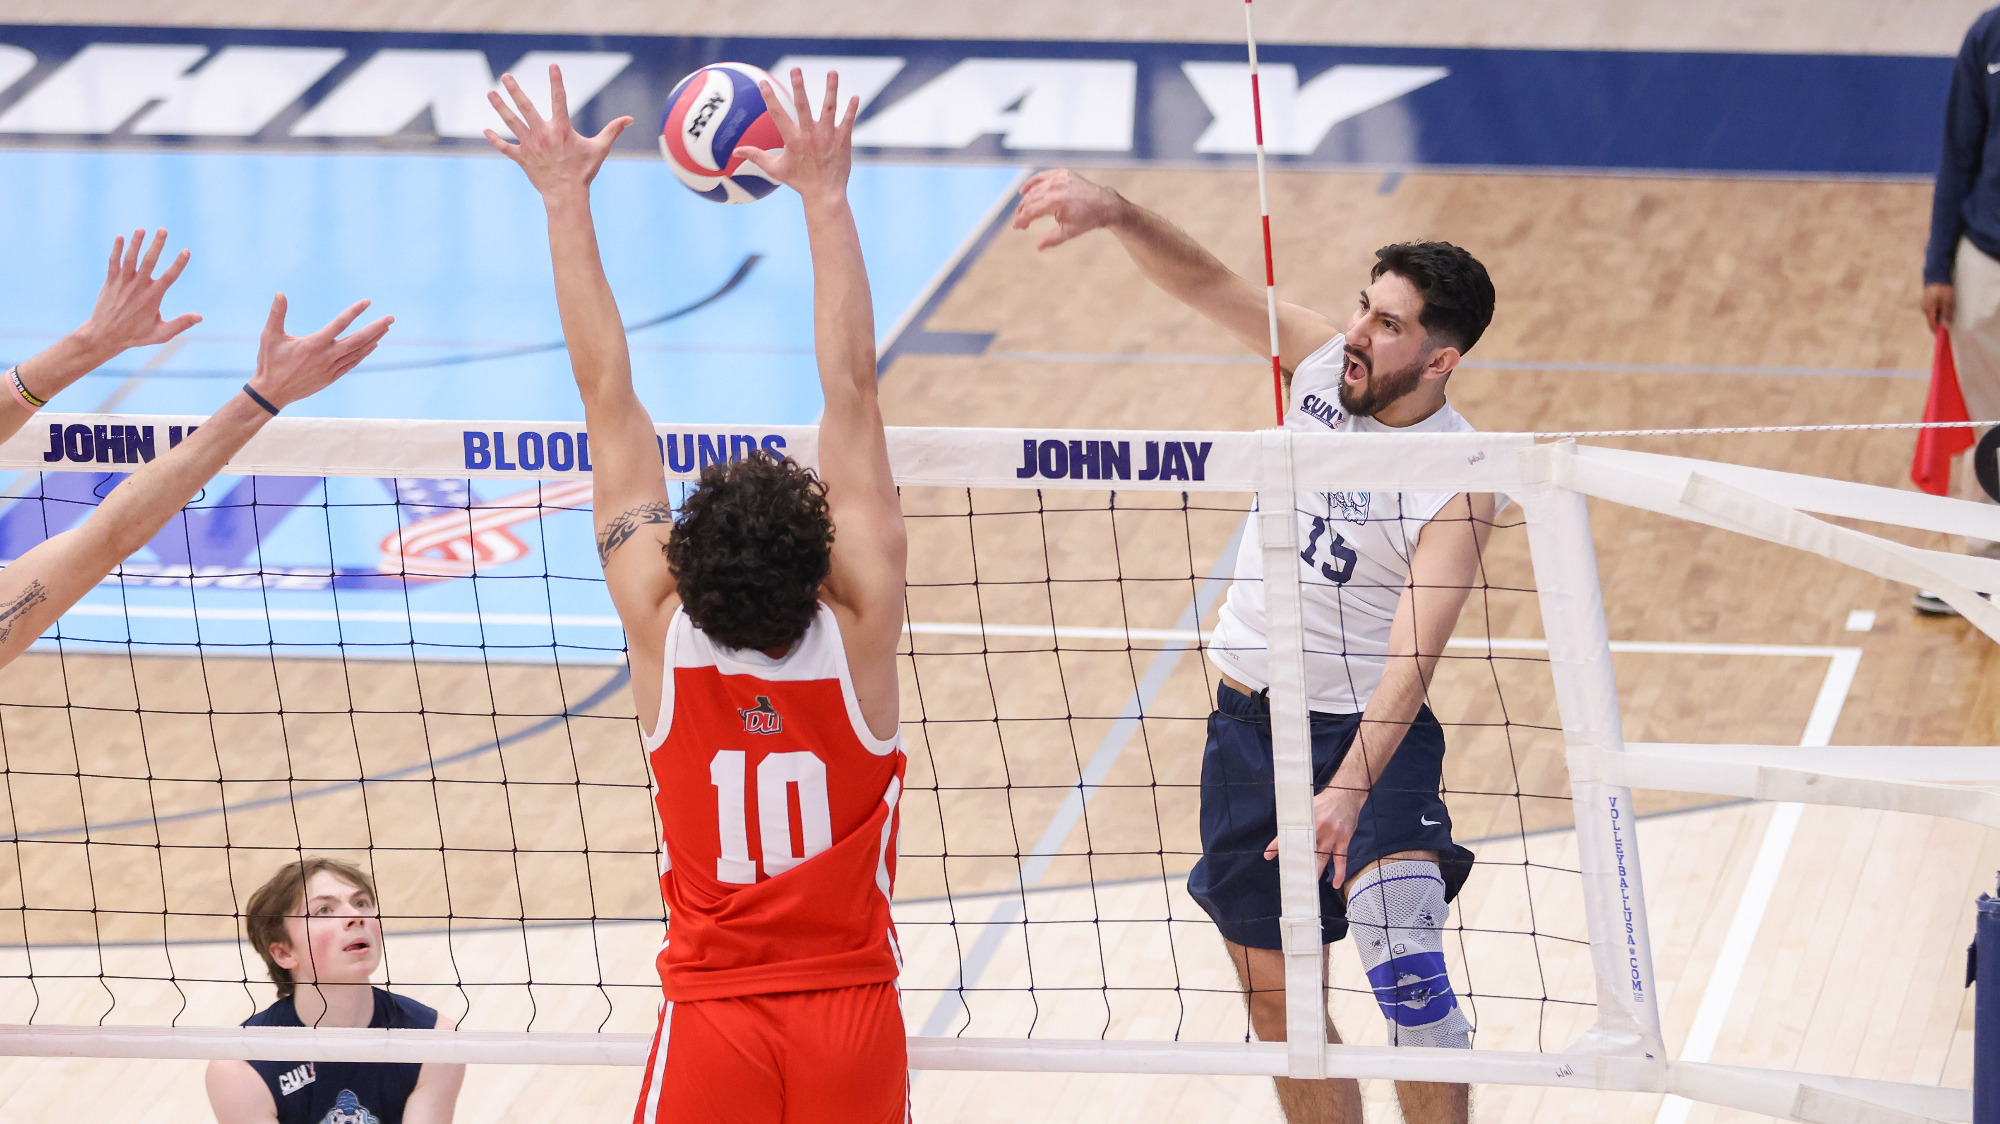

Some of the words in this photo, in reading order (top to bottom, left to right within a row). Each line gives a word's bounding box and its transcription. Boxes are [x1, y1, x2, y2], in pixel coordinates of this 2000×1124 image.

[0, 42, 633, 137] HN
[44, 424, 155, 463] JOHN
[464, 431, 787, 473] BLOOUNDS
[1017, 439, 1131, 480] JOHN
[1138, 441, 1213, 481] JAY
[1301, 516, 1357, 583] 15
[710, 749, 832, 884] 10
